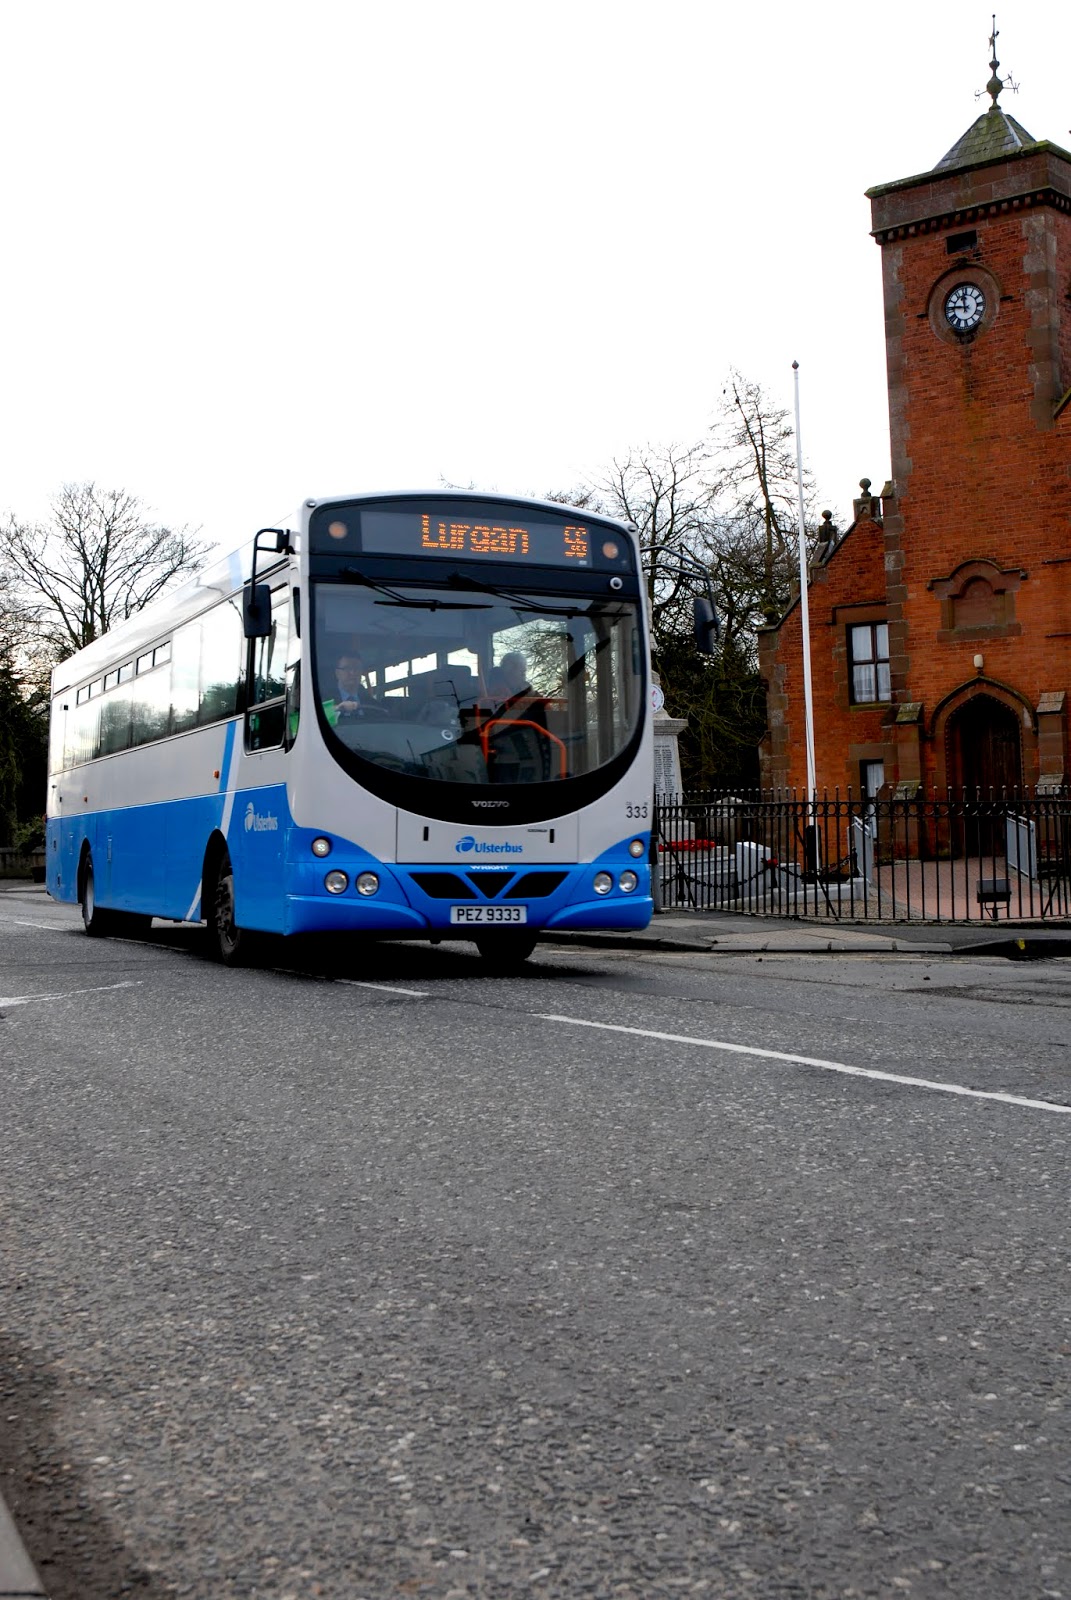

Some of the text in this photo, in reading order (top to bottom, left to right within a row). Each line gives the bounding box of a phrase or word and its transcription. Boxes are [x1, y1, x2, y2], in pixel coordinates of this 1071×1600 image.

[422, 514, 588, 558] Lurgan 56
[471, 800, 509, 808] VOLVO
[626, 805, 648, 819] 333
[474, 841, 523, 854] Ulsterbus
[457, 907, 521, 922] PEZ 9333
